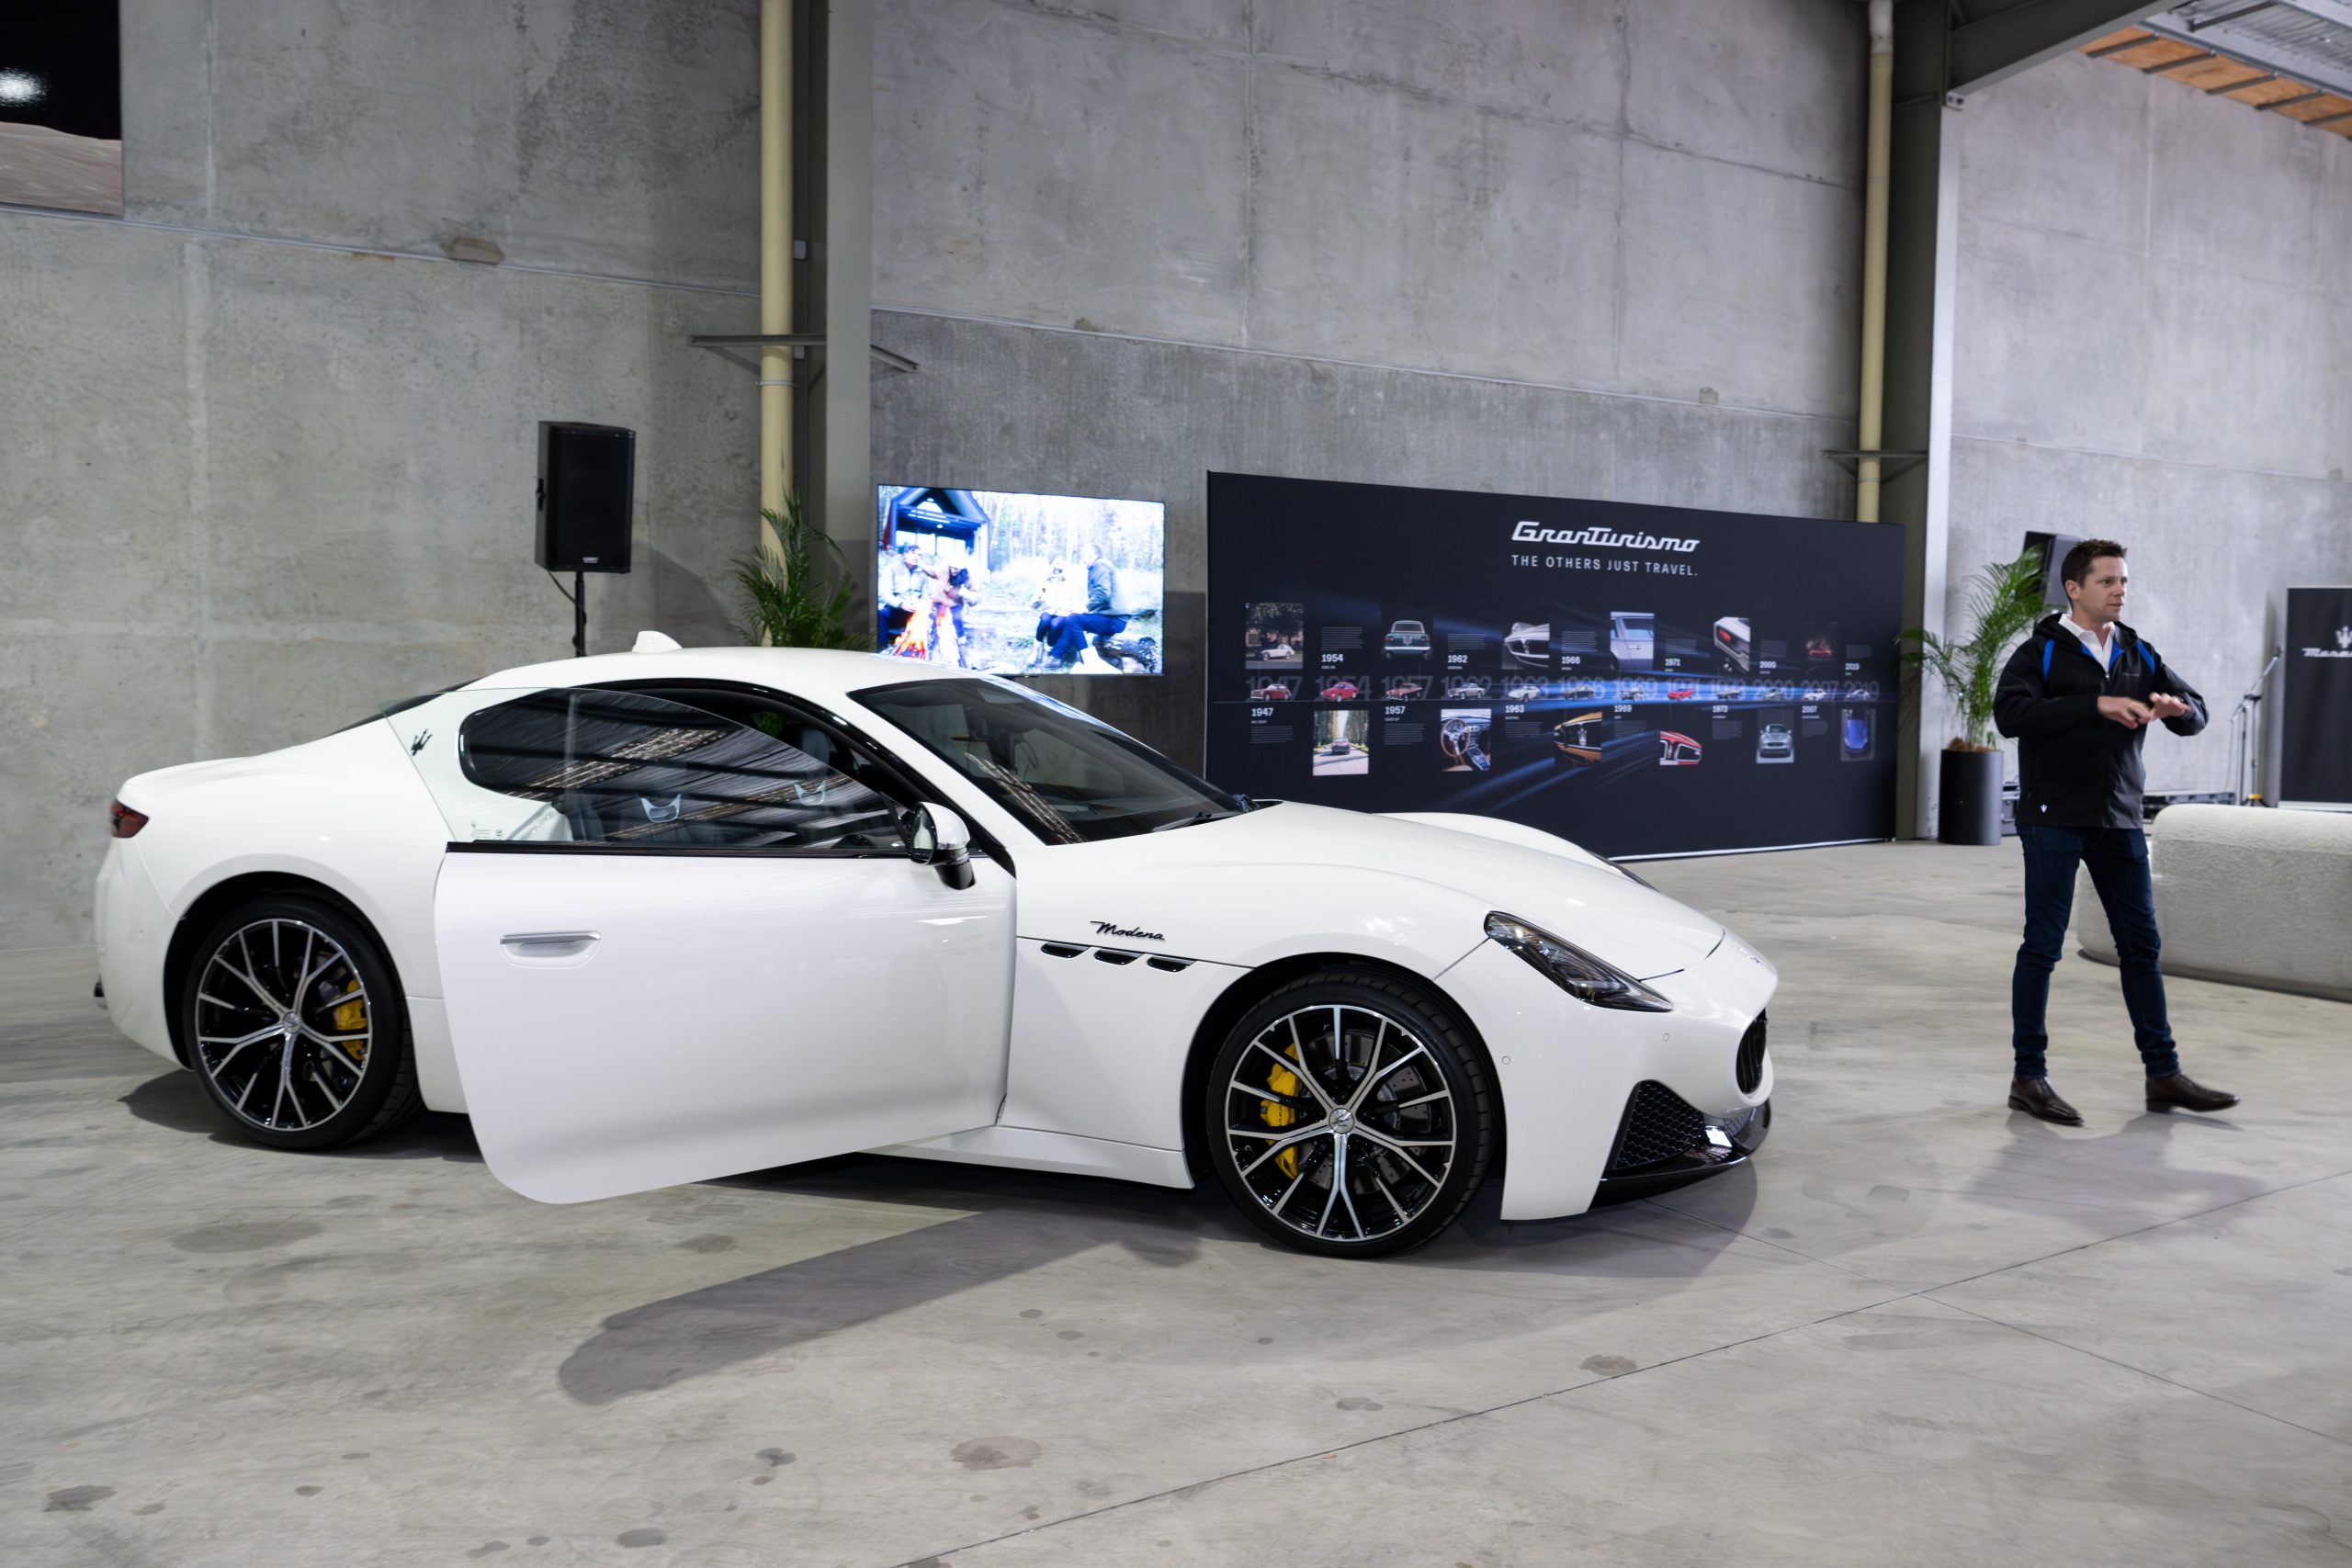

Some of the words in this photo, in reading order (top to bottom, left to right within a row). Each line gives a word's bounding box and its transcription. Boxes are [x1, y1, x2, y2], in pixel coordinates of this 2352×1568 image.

[1511, 520, 1700, 552] GranTurismo
[1511, 554, 1539, 567] THE
[1545, 556, 1601, 570] OTHERS
[1607, 559, 1639, 572] JUST
[1645, 561, 1698, 576] TRAVEL.
[1321, 653, 1343, 662] 1954
[1447, 654, 1468, 663] 1962
[1251, 707, 1274, 716] 1947
[1385, 705, 1406, 715] 1957
[1505, 705, 1525, 713] 1963
[1091, 920, 1165, 941] Modena
